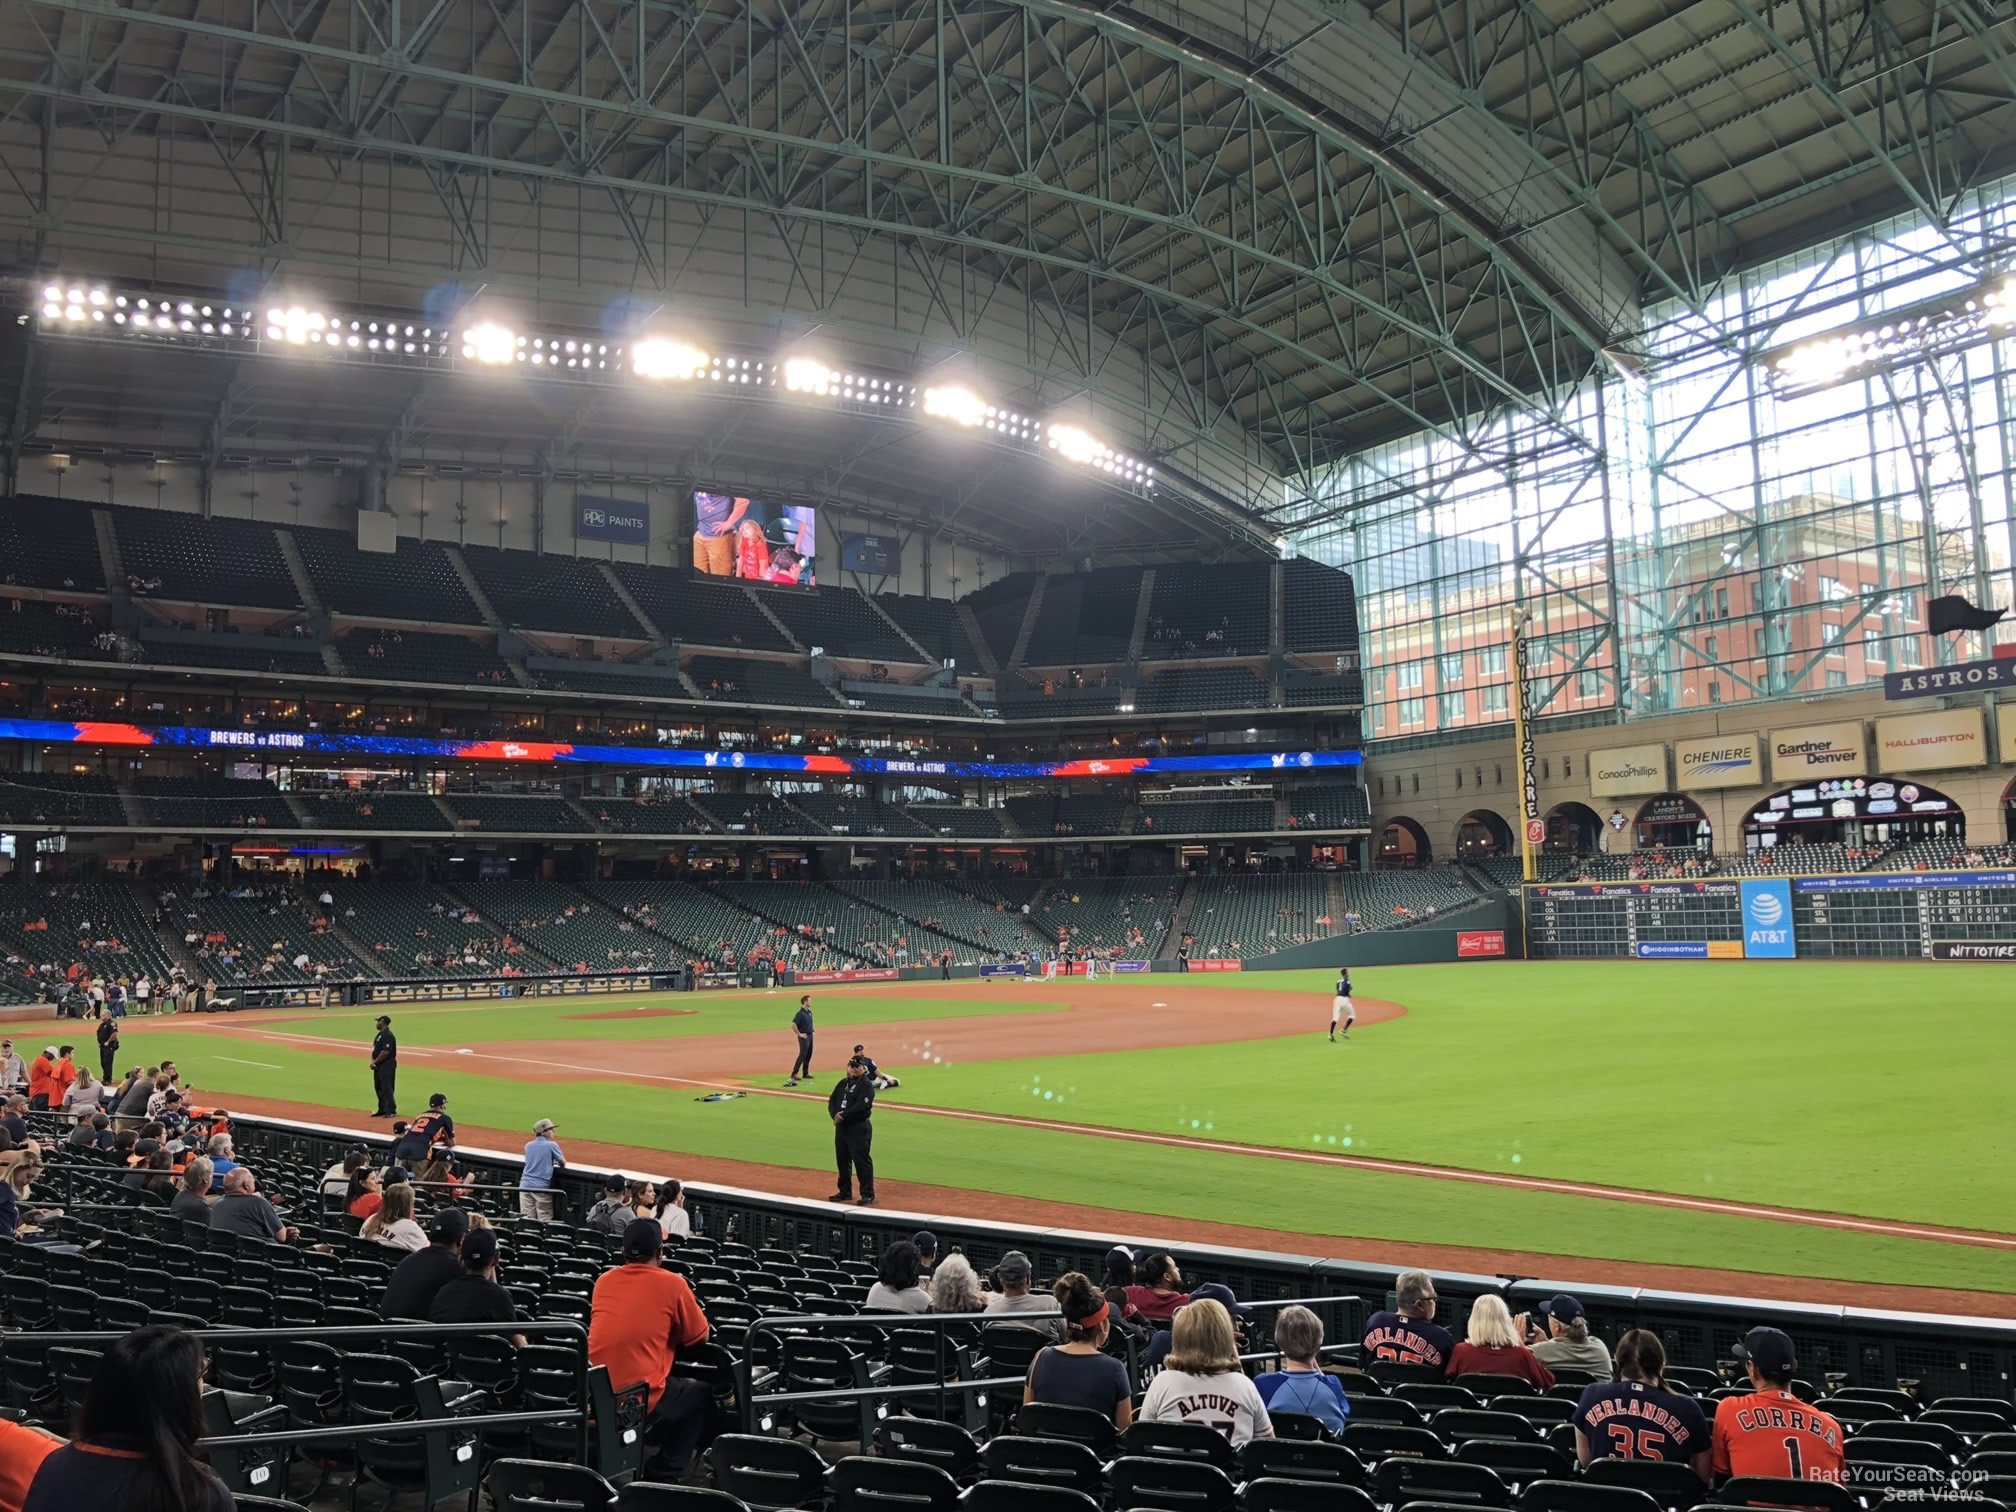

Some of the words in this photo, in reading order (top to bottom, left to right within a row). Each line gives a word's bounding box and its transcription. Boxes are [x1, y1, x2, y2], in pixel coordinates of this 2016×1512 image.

[585, 511, 604, 524] PPG
[609, 516, 643, 528] PAINTS
[1518, 639, 1532, 721] CHIKIN
[1901, 666, 1998, 692] ASTROS
[210, 731, 255, 744] BREWERS
[268, 734, 304, 746] ASTROS
[1524, 725, 1534, 752] IZ
[1886, 733, 1975, 748] HALLIBURTON
[1683, 747, 1752, 764] CHENIERE
[1777, 740, 1832, 755] Gardner
[887, 761, 915, 771] BREWERS
[923, 763, 945, 772] ASTROS
[1807, 751, 1857, 765] Denver
[1598, 766, 1658, 780] ConocoPhillips
[1524, 757, 1538, 817] FARE
[1644, 814, 1676, 822] CRAWFORD
[1705, 884, 1736, 892] Fanatics
[1750, 930, 1787, 944] AT&T
[411, 1117, 430, 1132] 2
[1177, 1394, 1239, 1418] ALTUVE
[1585, 1398, 1689, 1446] VERLANDER
[1736, 1407, 1836, 1448] CORREA
[1608, 1424, 1664, 1462] 35
[1783, 1436, 1804, 1479] 1
